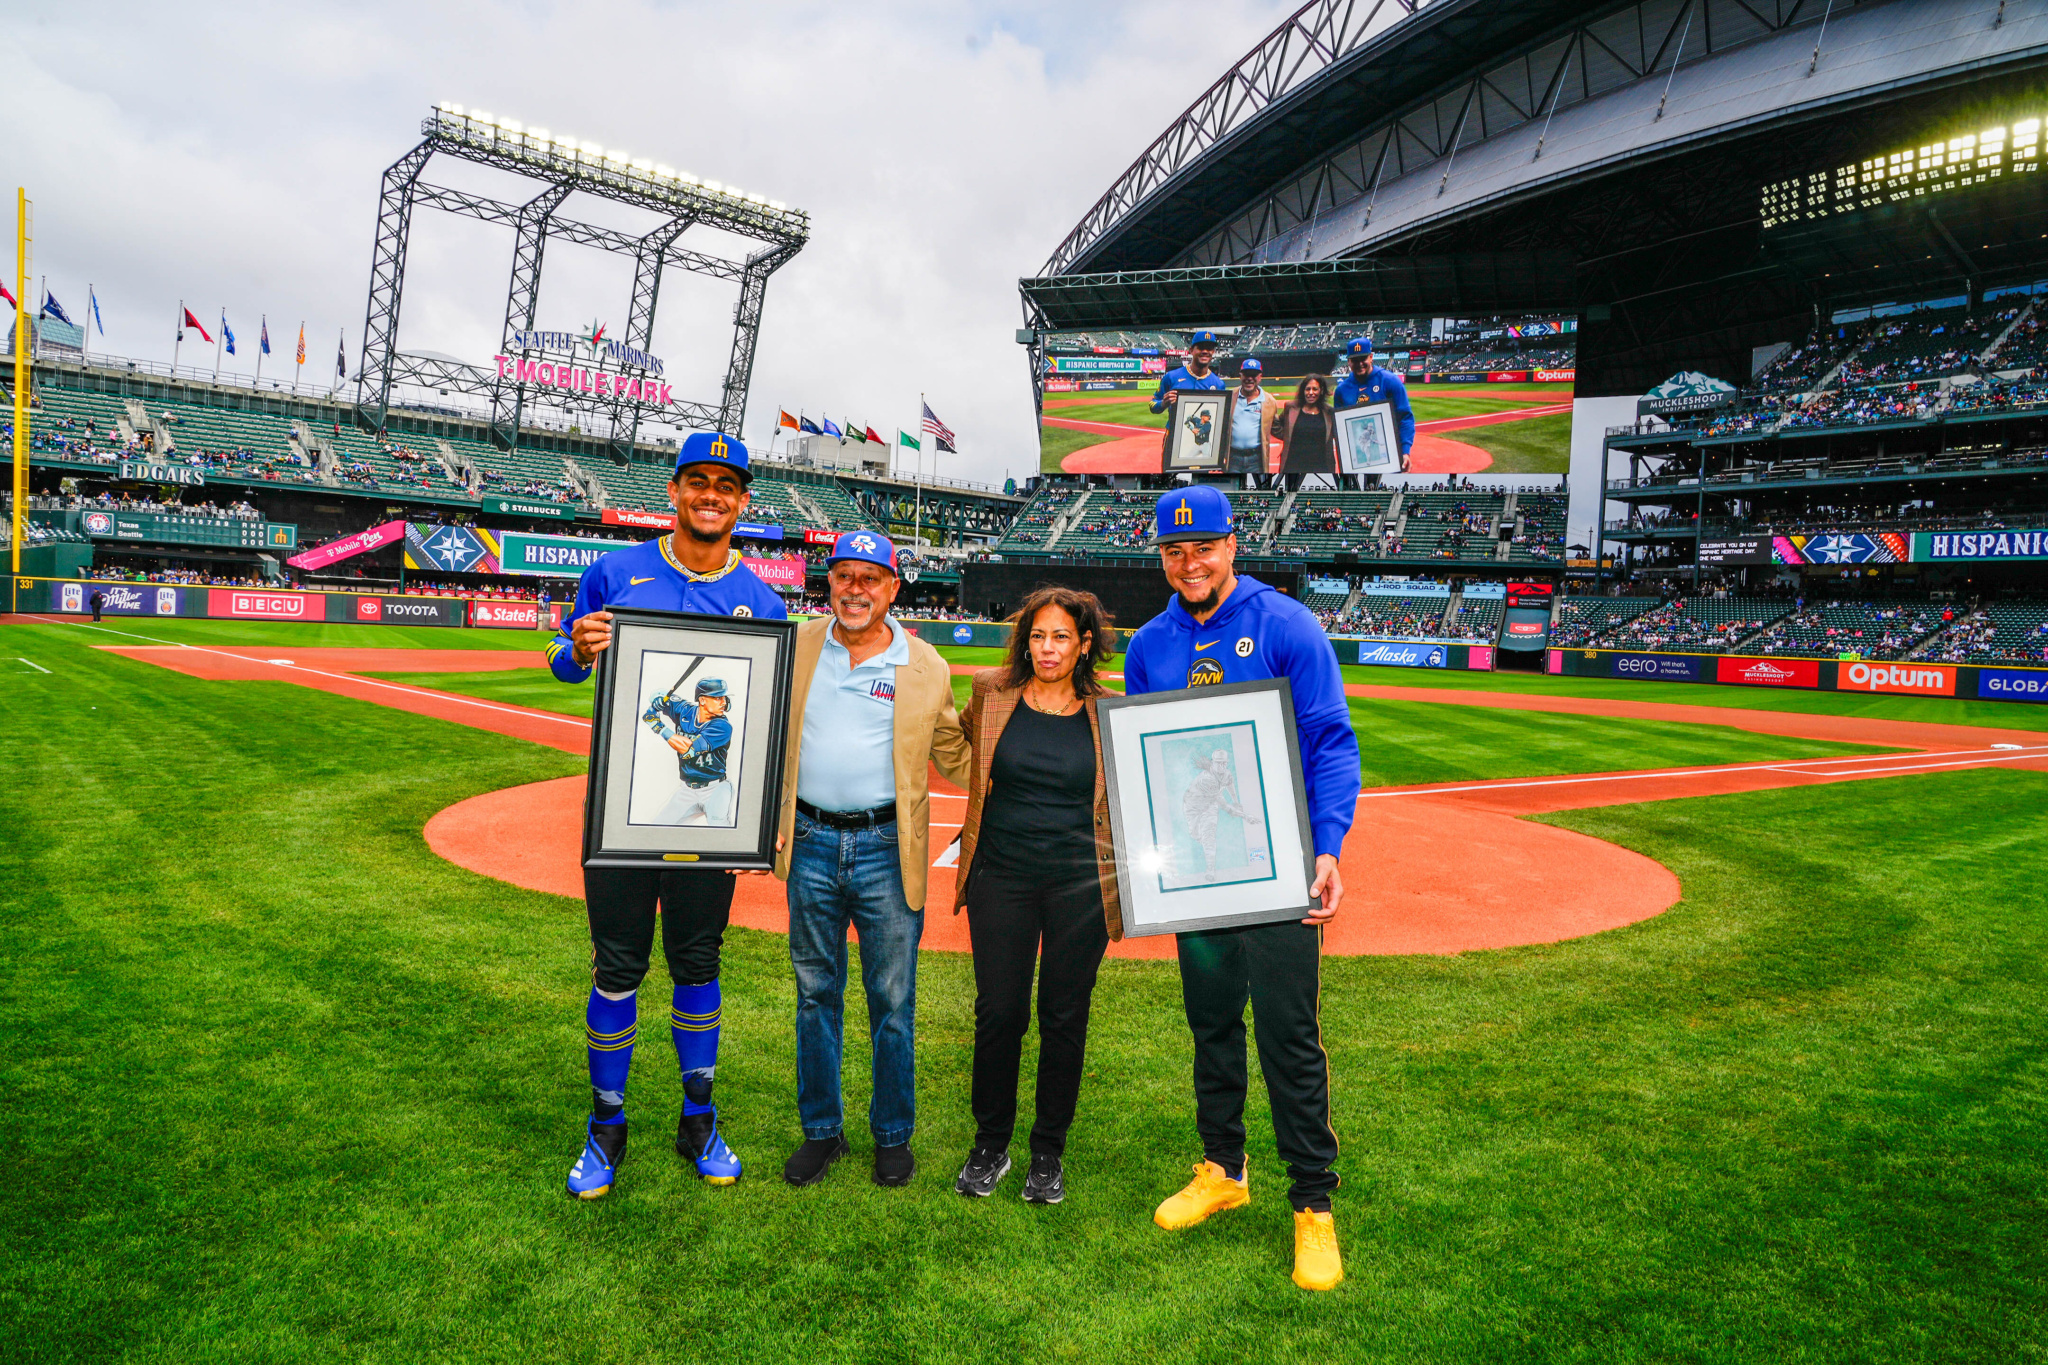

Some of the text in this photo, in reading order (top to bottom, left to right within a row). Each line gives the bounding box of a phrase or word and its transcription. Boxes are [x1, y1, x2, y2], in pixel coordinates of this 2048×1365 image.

[514, 329, 664, 376] SEATTLE MARINERS
[494, 354, 673, 405] T-MOBILE PARK
[1537, 371, 1575, 381] Optum
[1650, 394, 1723, 409] MUCKLESHOOT
[512, 504, 561, 516] STARBUCKS
[336, 541, 360, 555] Mobile
[758, 564, 794, 579] Mobile
[20, 580, 33, 589] 331
[65, 587, 80, 596] Lite
[160, 592, 174, 600] Lite
[101, 592, 142, 608] Miller
[118, 601, 140, 609] TIME
[386, 603, 438, 616] TOYOTA
[1239, 642, 1250, 652] 21
[1362, 646, 1418, 664] Alaska
[1584, 651, 1596, 659] 380
[1619, 659, 1657, 672] eero
[1849, 663, 1943, 690] Optum
[696, 753, 713, 767] 44
